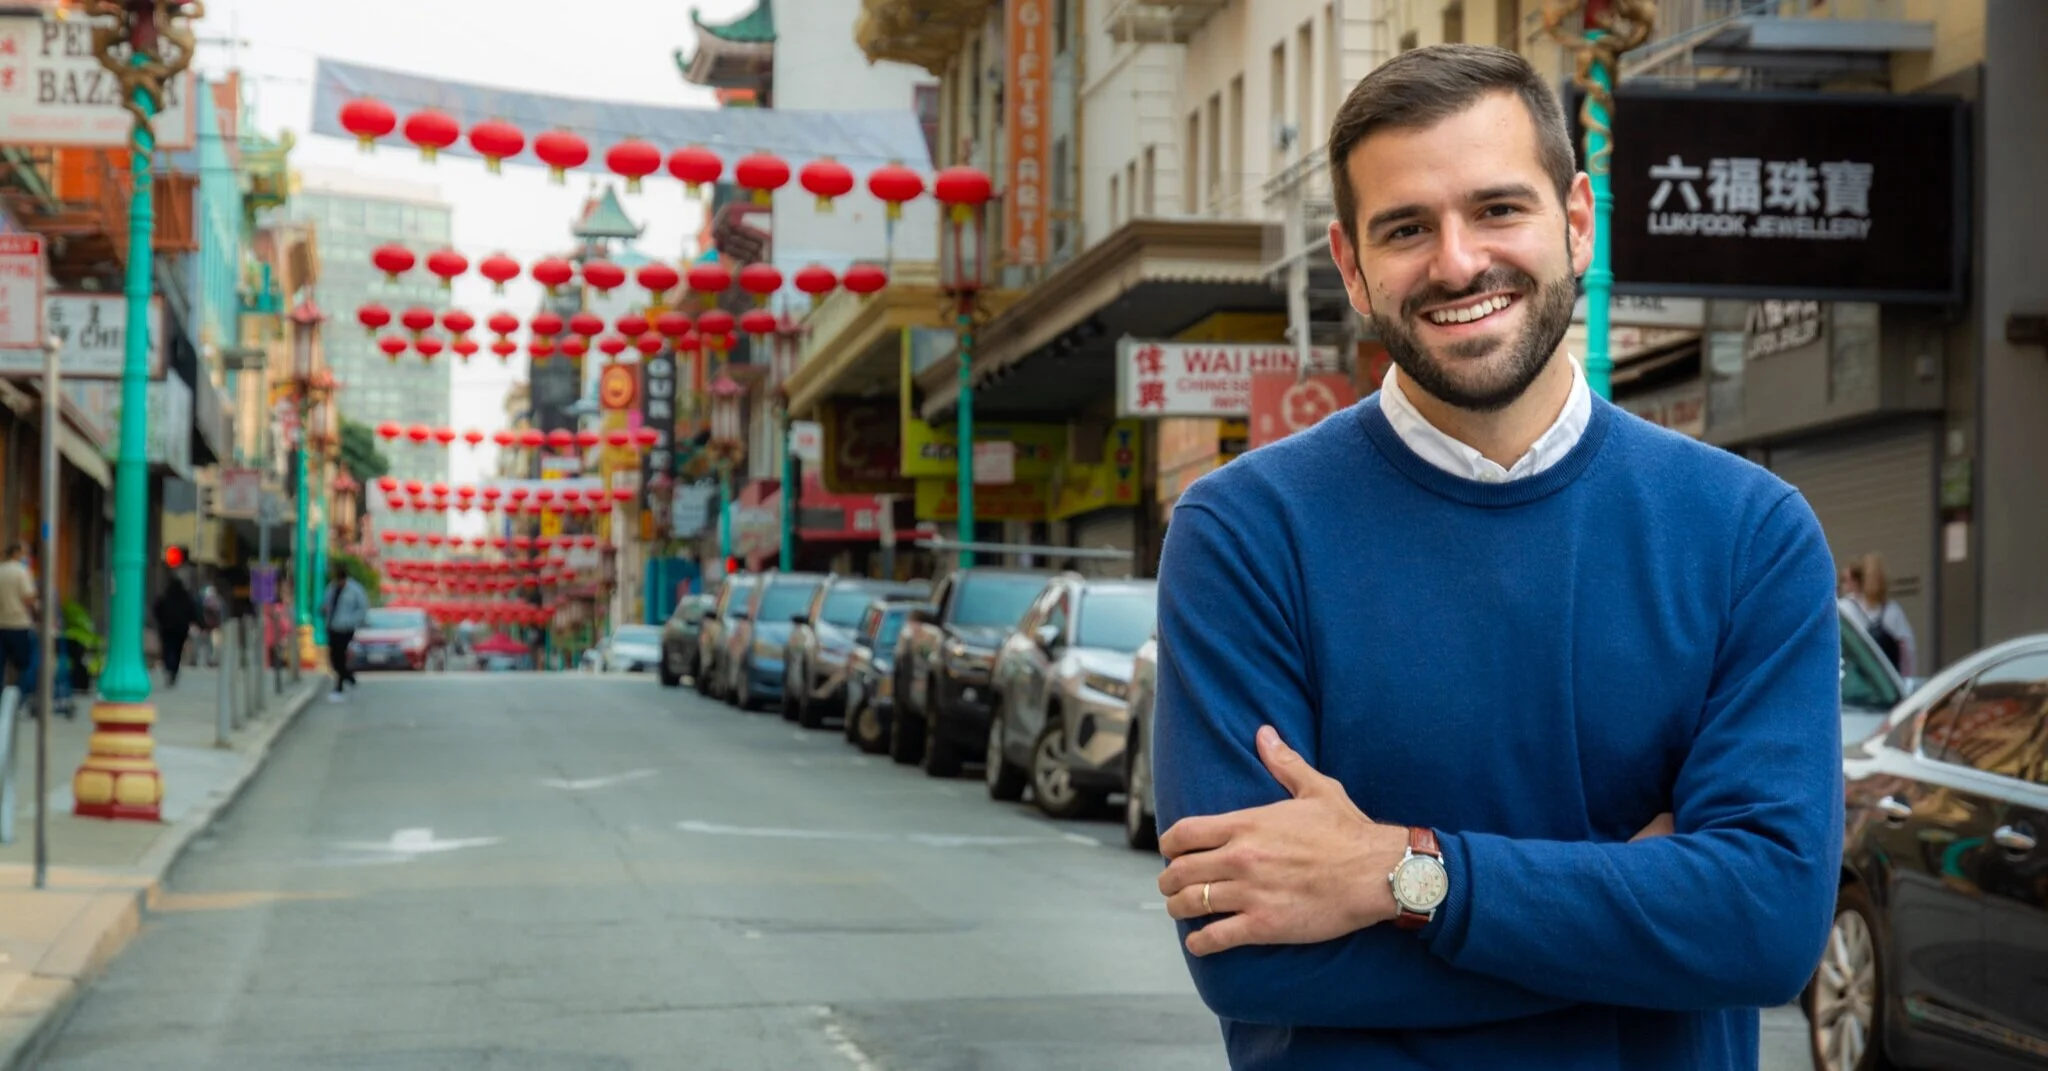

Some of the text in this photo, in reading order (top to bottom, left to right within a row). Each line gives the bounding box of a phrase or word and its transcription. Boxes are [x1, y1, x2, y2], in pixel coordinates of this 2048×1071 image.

[1649, 154, 1874, 216] 六福珠寶
[1648, 212, 1872, 239] LUKFOOK JEWELLERY
[1183, 349, 1241, 373] WAI
